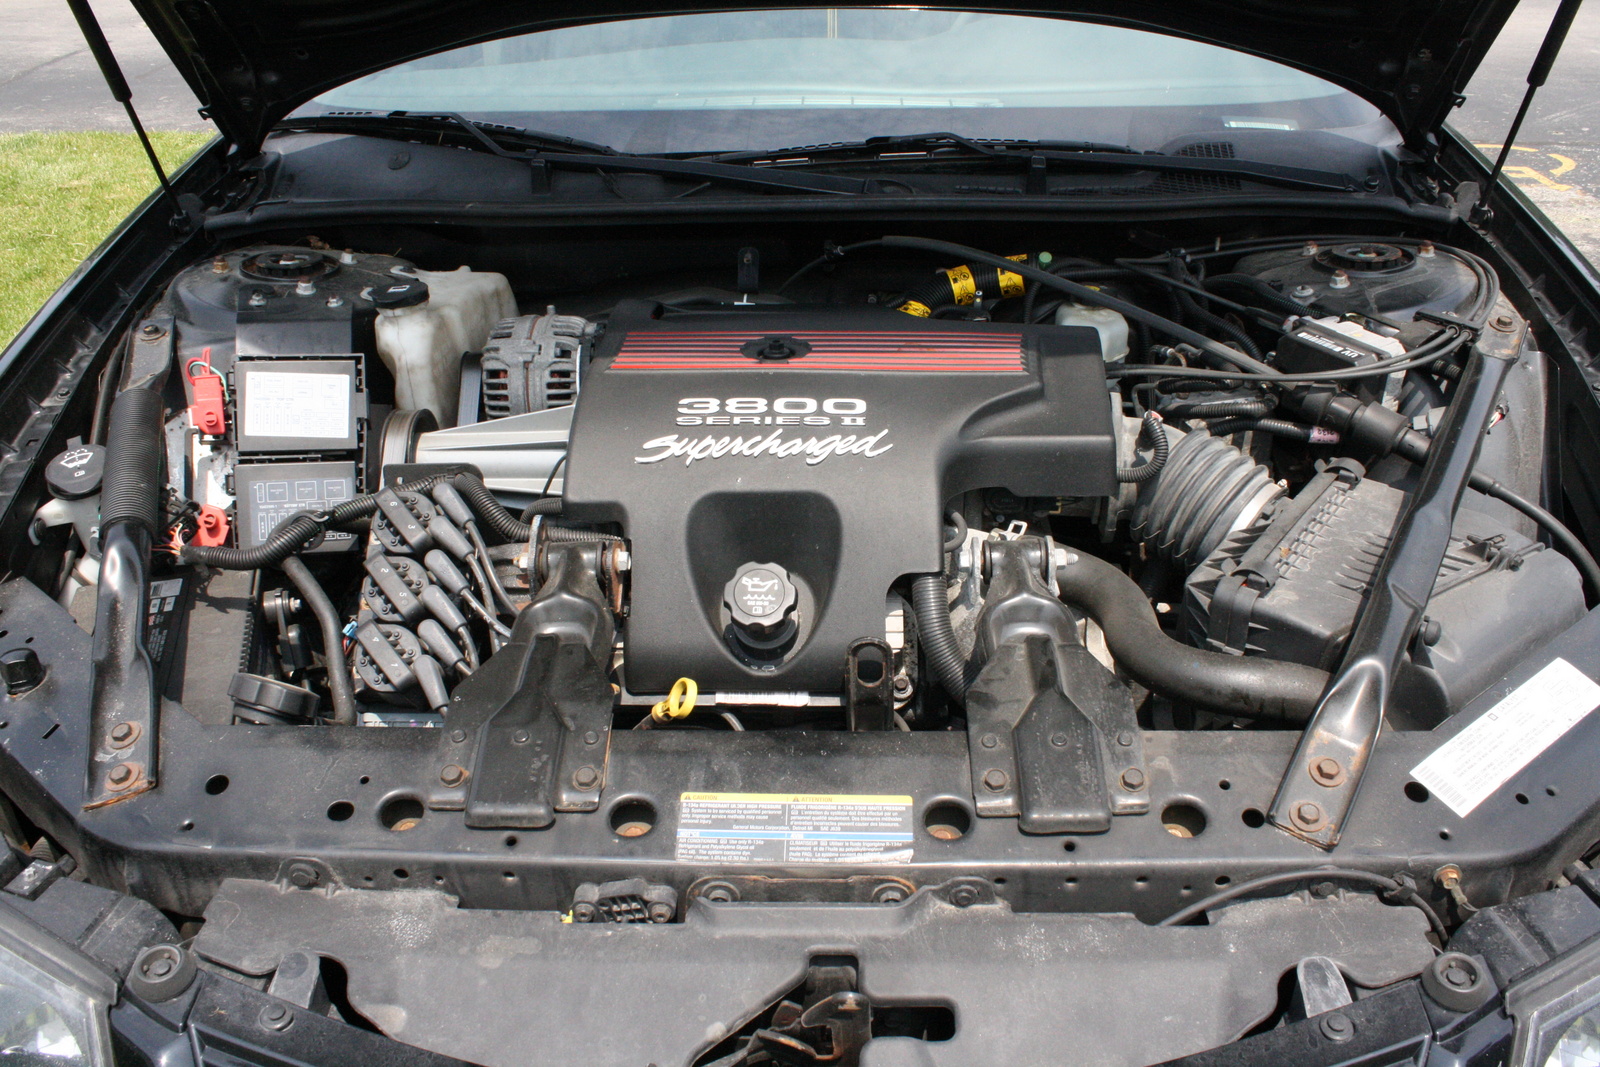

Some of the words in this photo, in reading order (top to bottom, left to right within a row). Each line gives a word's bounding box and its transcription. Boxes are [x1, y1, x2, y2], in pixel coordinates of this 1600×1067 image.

[678, 397, 866, 414] 3800
[676, 416, 831, 426] SERIES
[840, 416, 866, 426] II
[634, 428, 894, 466] Supercharged
